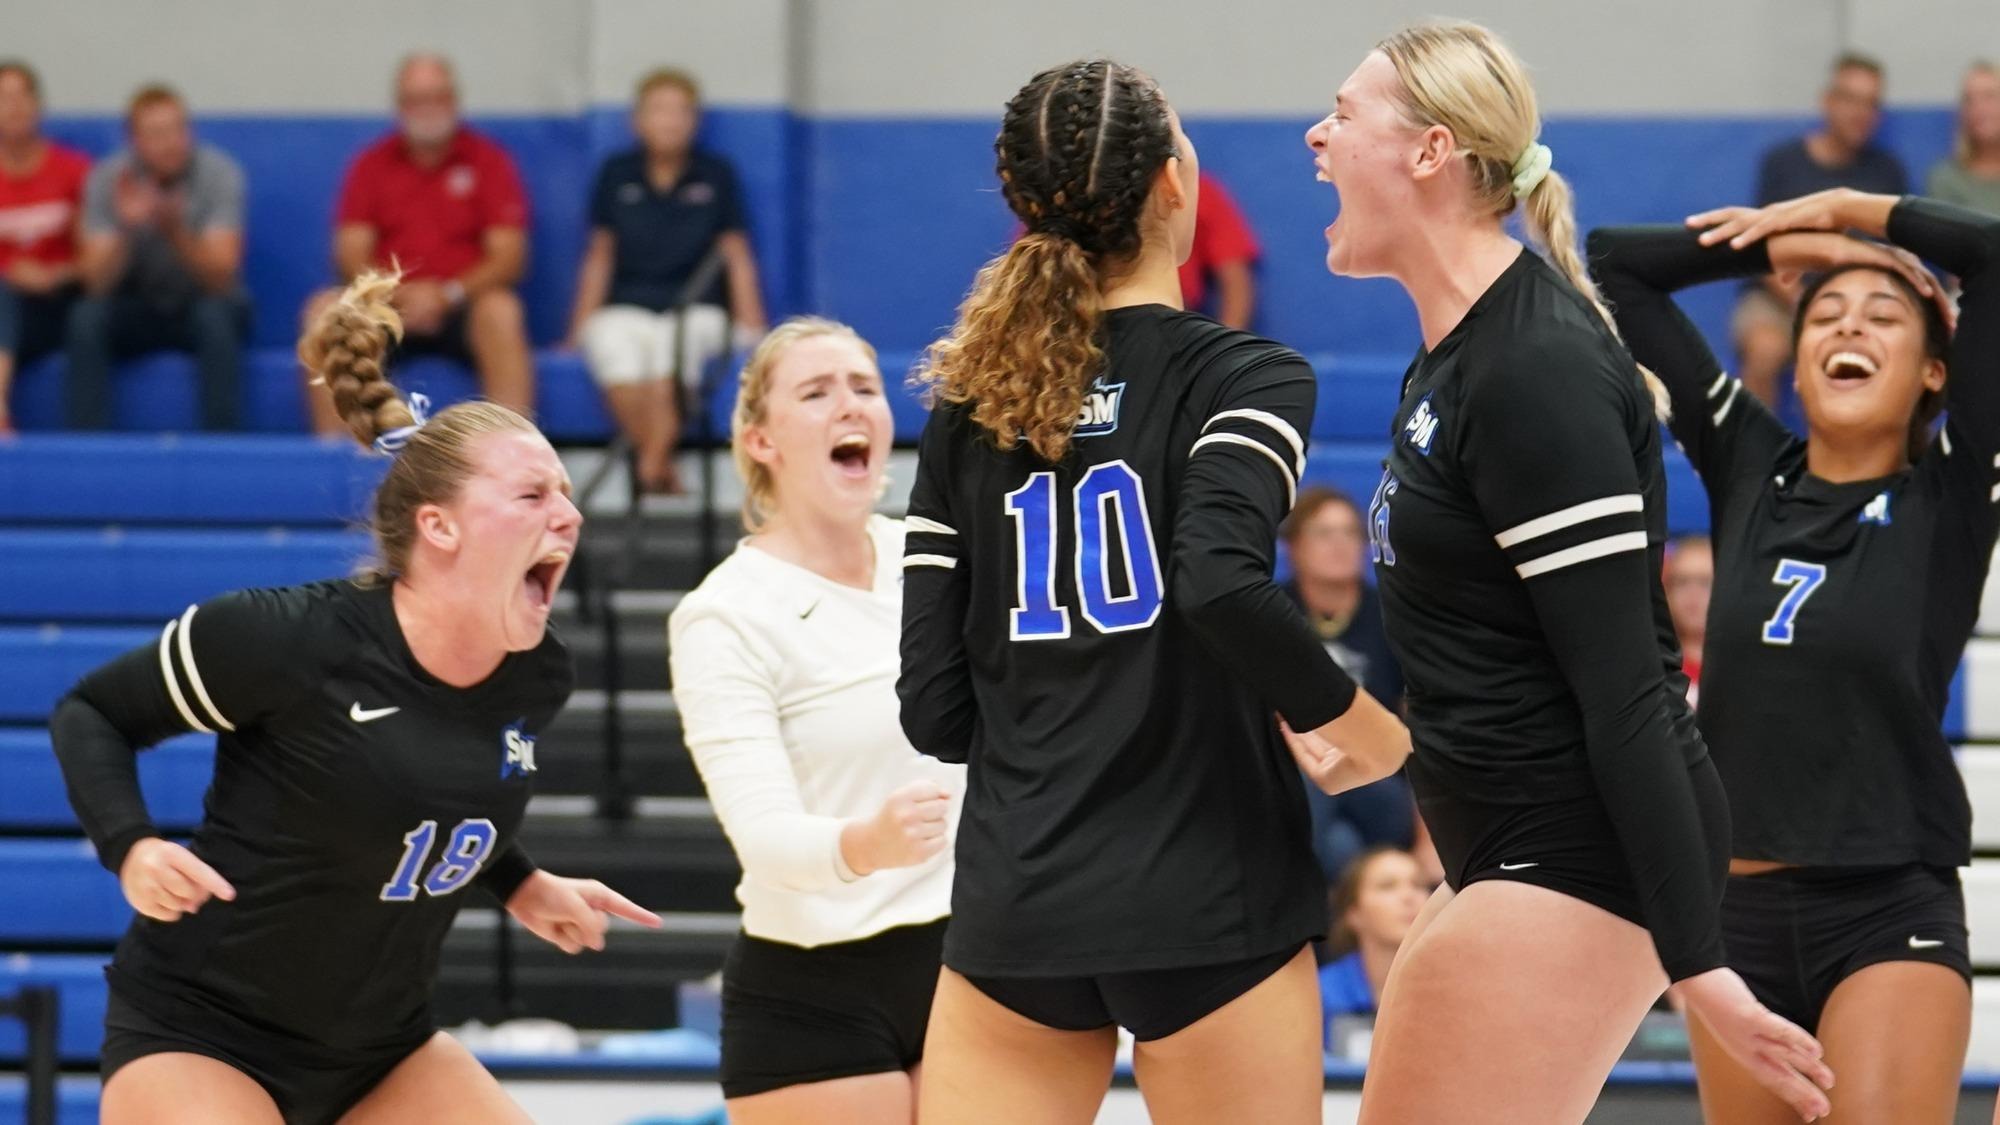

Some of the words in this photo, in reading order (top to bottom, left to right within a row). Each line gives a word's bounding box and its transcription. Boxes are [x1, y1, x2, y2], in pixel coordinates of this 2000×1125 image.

[1404, 399, 1440, 449] SM
[1004, 458, 1165, 642] 10
[1762, 558, 1827, 645] 7
[504, 728, 538, 772] SM
[378, 818, 498, 902] 18
